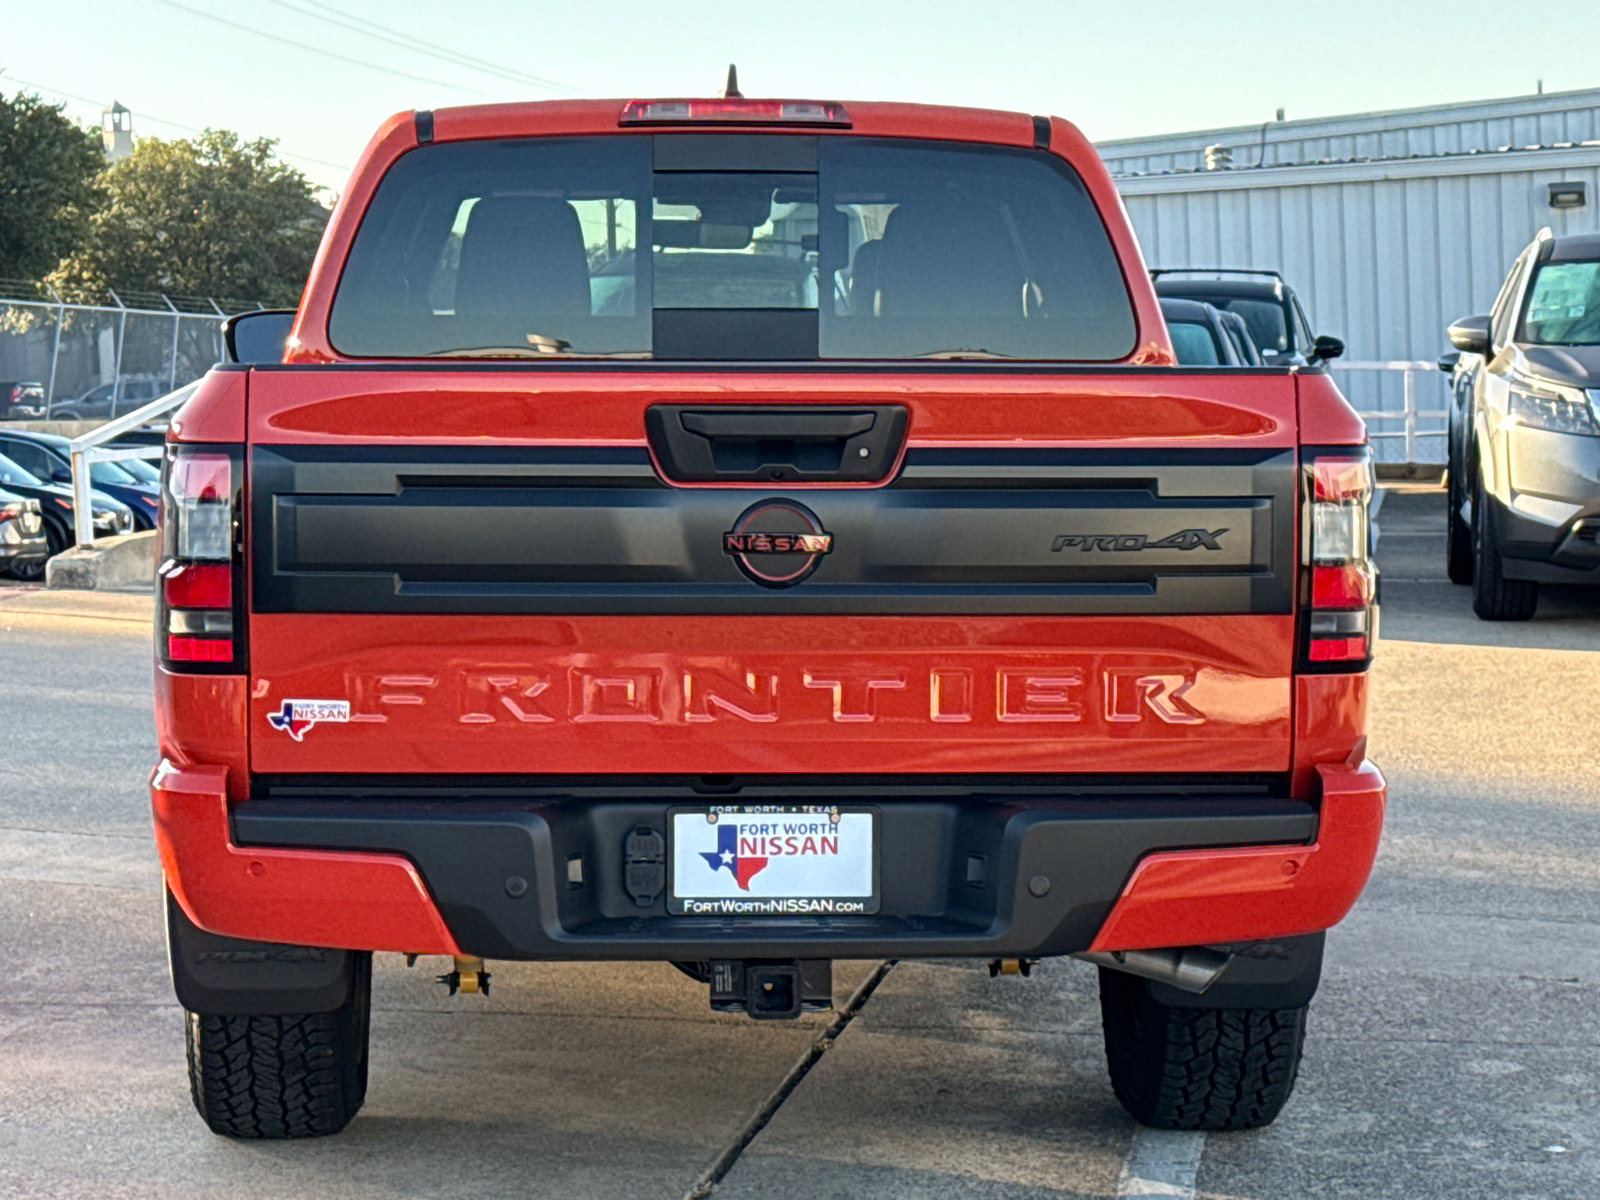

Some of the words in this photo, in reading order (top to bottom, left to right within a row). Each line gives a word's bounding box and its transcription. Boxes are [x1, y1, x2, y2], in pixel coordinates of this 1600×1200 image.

[727, 535, 830, 552] NISSAN
[1050, 528, 1230, 552] PRO-4X
[345, 667, 1206, 724] FRONTIER
[293, 709, 347, 720] NISSAN
[709, 805, 739, 814] FORT
[744, 805, 785, 814] WORTH
[802, 805, 838, 814] TEXAS
[739, 823, 779, 836] FORT
[783, 823, 839, 835] WORTH
[739, 836, 839, 856] NISSAN
